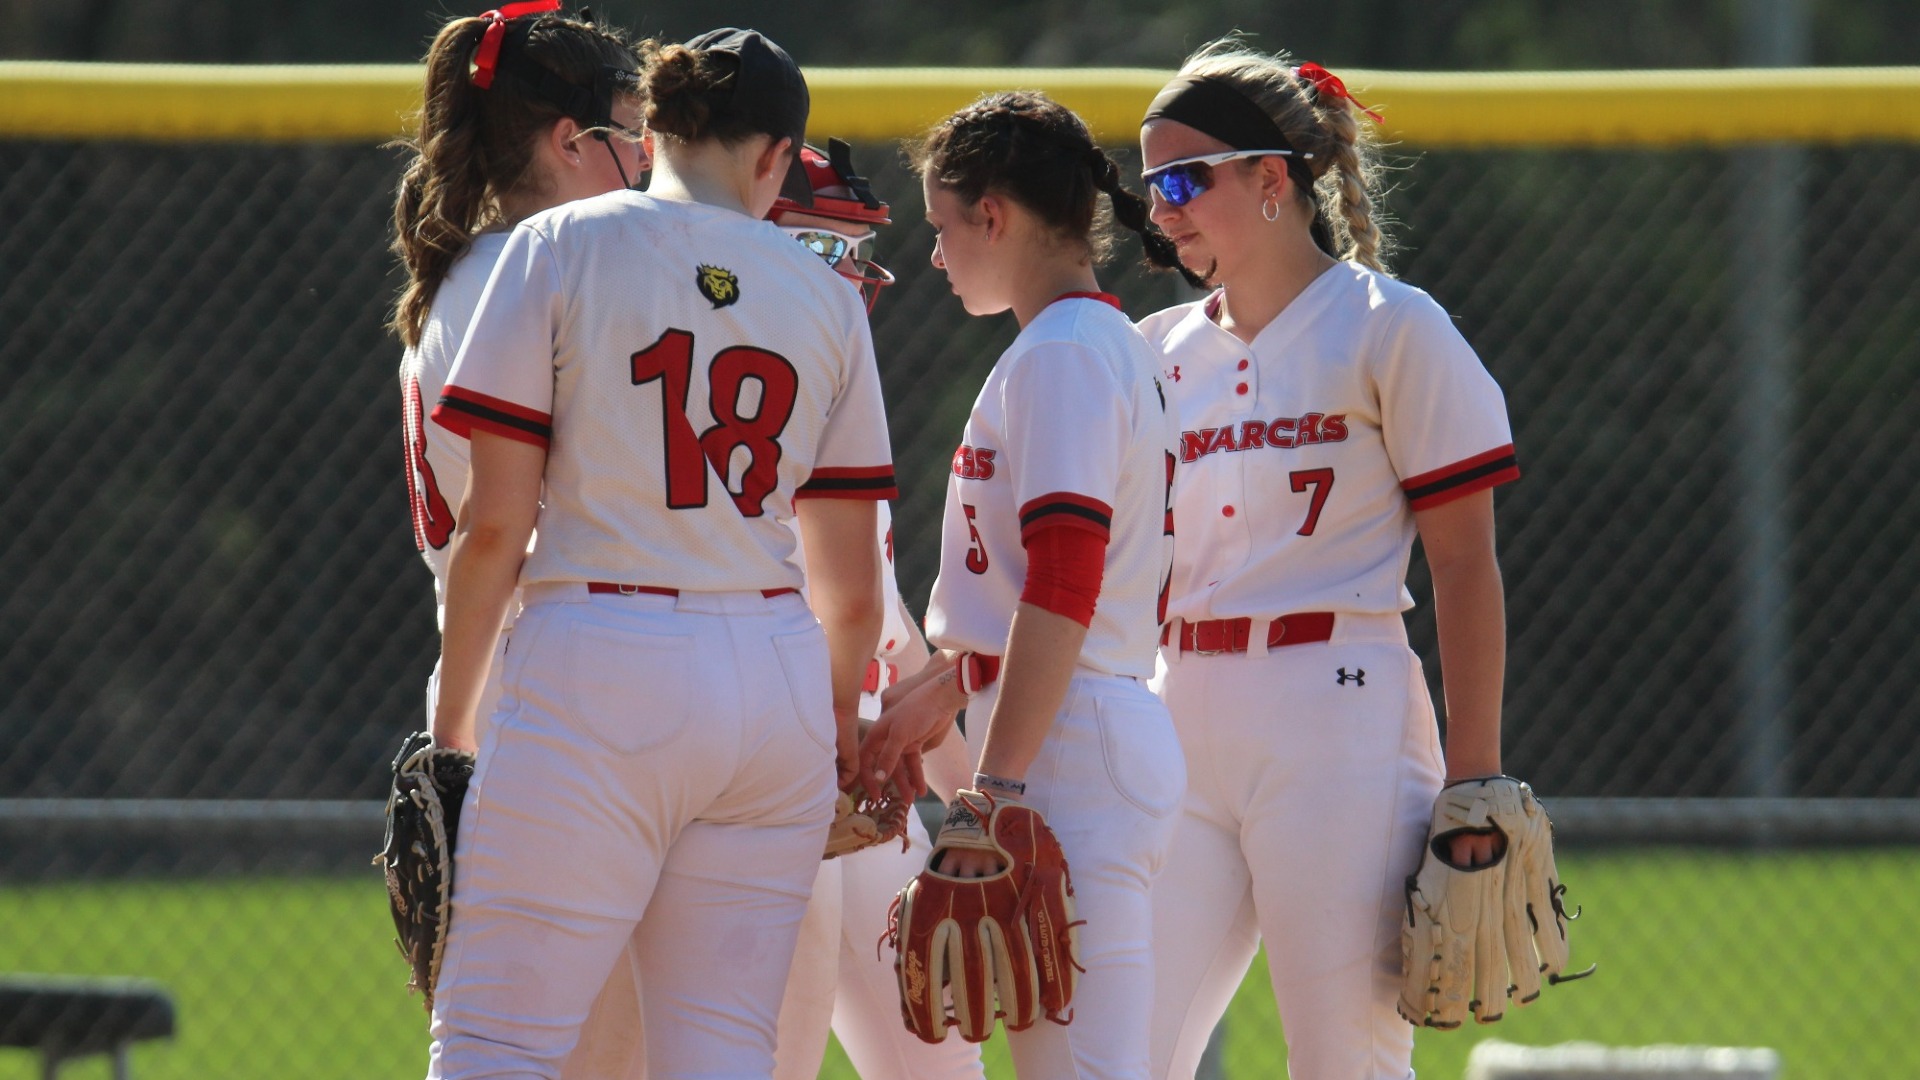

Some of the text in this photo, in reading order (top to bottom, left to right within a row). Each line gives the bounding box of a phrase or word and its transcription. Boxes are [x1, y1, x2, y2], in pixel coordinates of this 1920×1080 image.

[630, 327, 799, 518] 18
[1180, 412, 1349, 463] NARCHS
[1289, 467, 1335, 536] 7
[962, 503, 989, 575] 5
